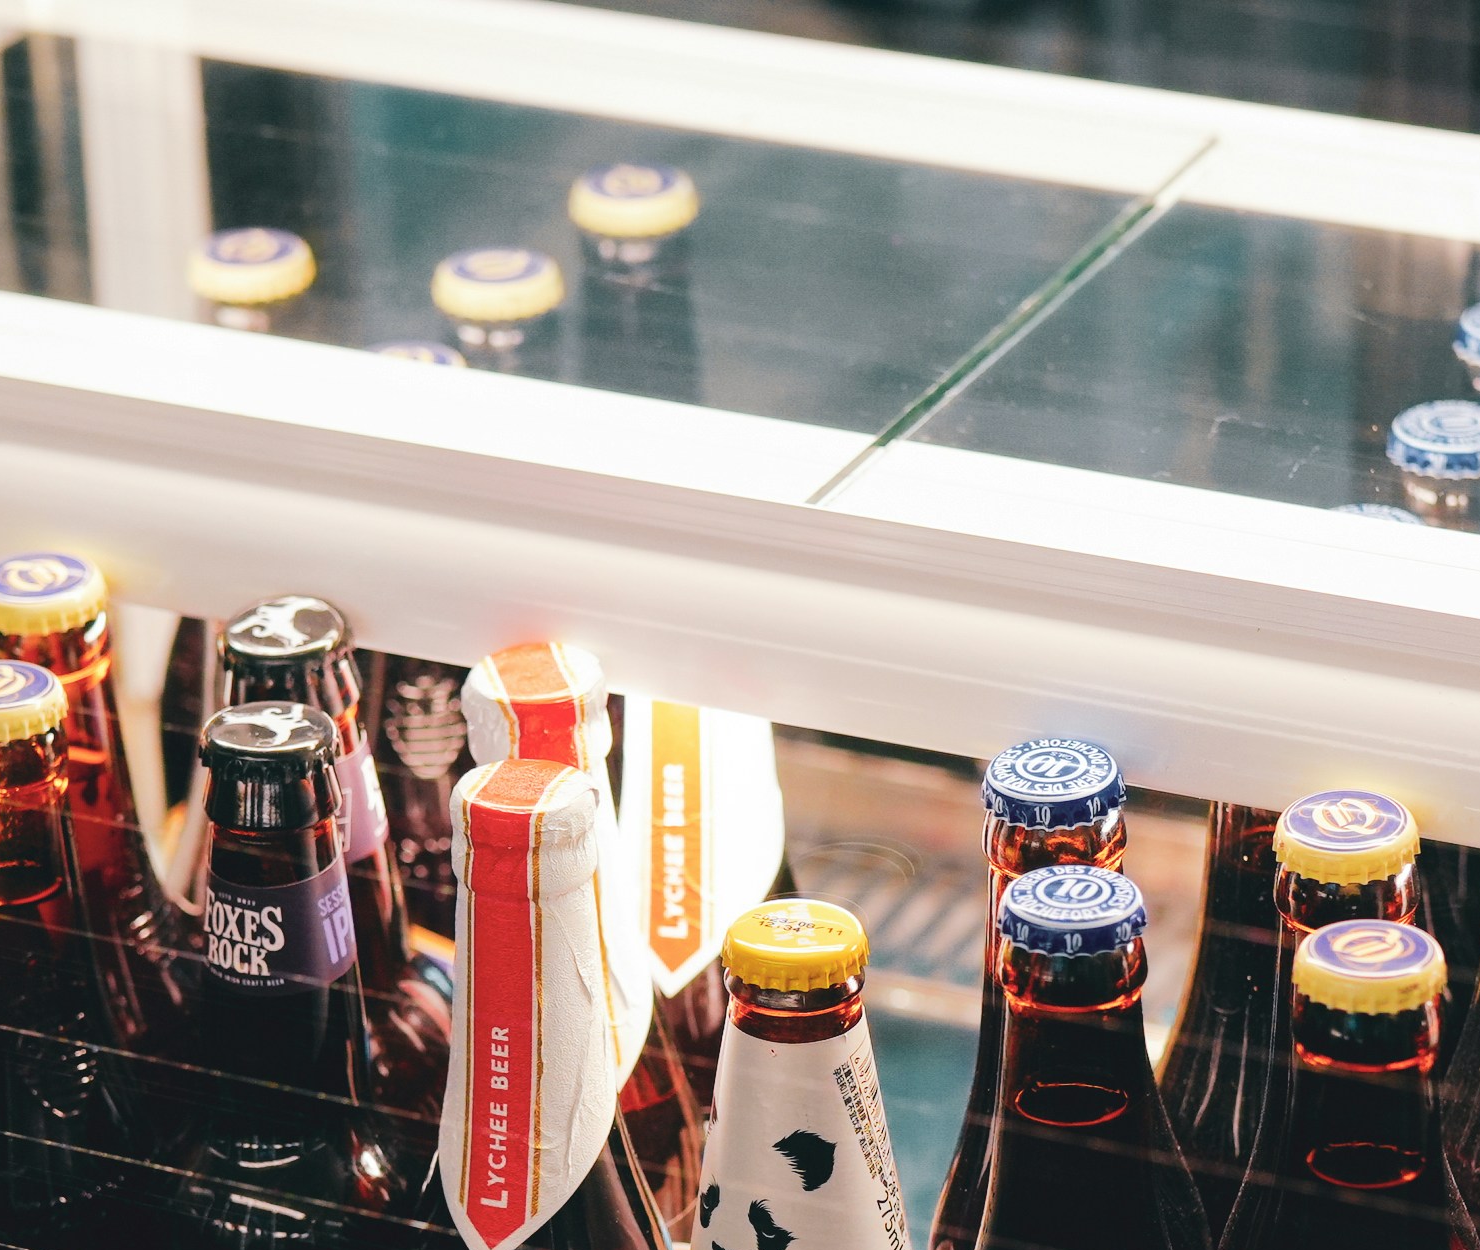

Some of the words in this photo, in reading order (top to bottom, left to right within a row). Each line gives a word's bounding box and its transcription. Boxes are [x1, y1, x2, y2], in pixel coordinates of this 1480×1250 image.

[1029, 739, 1109, 766] ROCHEFORT
[663, 763, 685, 829] BEER
[1034, 805, 1051, 826] 10
[658, 834, 688, 940] LYCHEE
[1053, 865, 1085, 875] DES
[1054, 878, 1099, 900] 10
[204, 886, 285, 952] FOXES
[208, 934, 271, 976] ROCK
[1064, 933, 1082, 953] 10
[490, 1026, 510, 1091] BEER
[480, 1102, 509, 1209] LYCHEE
